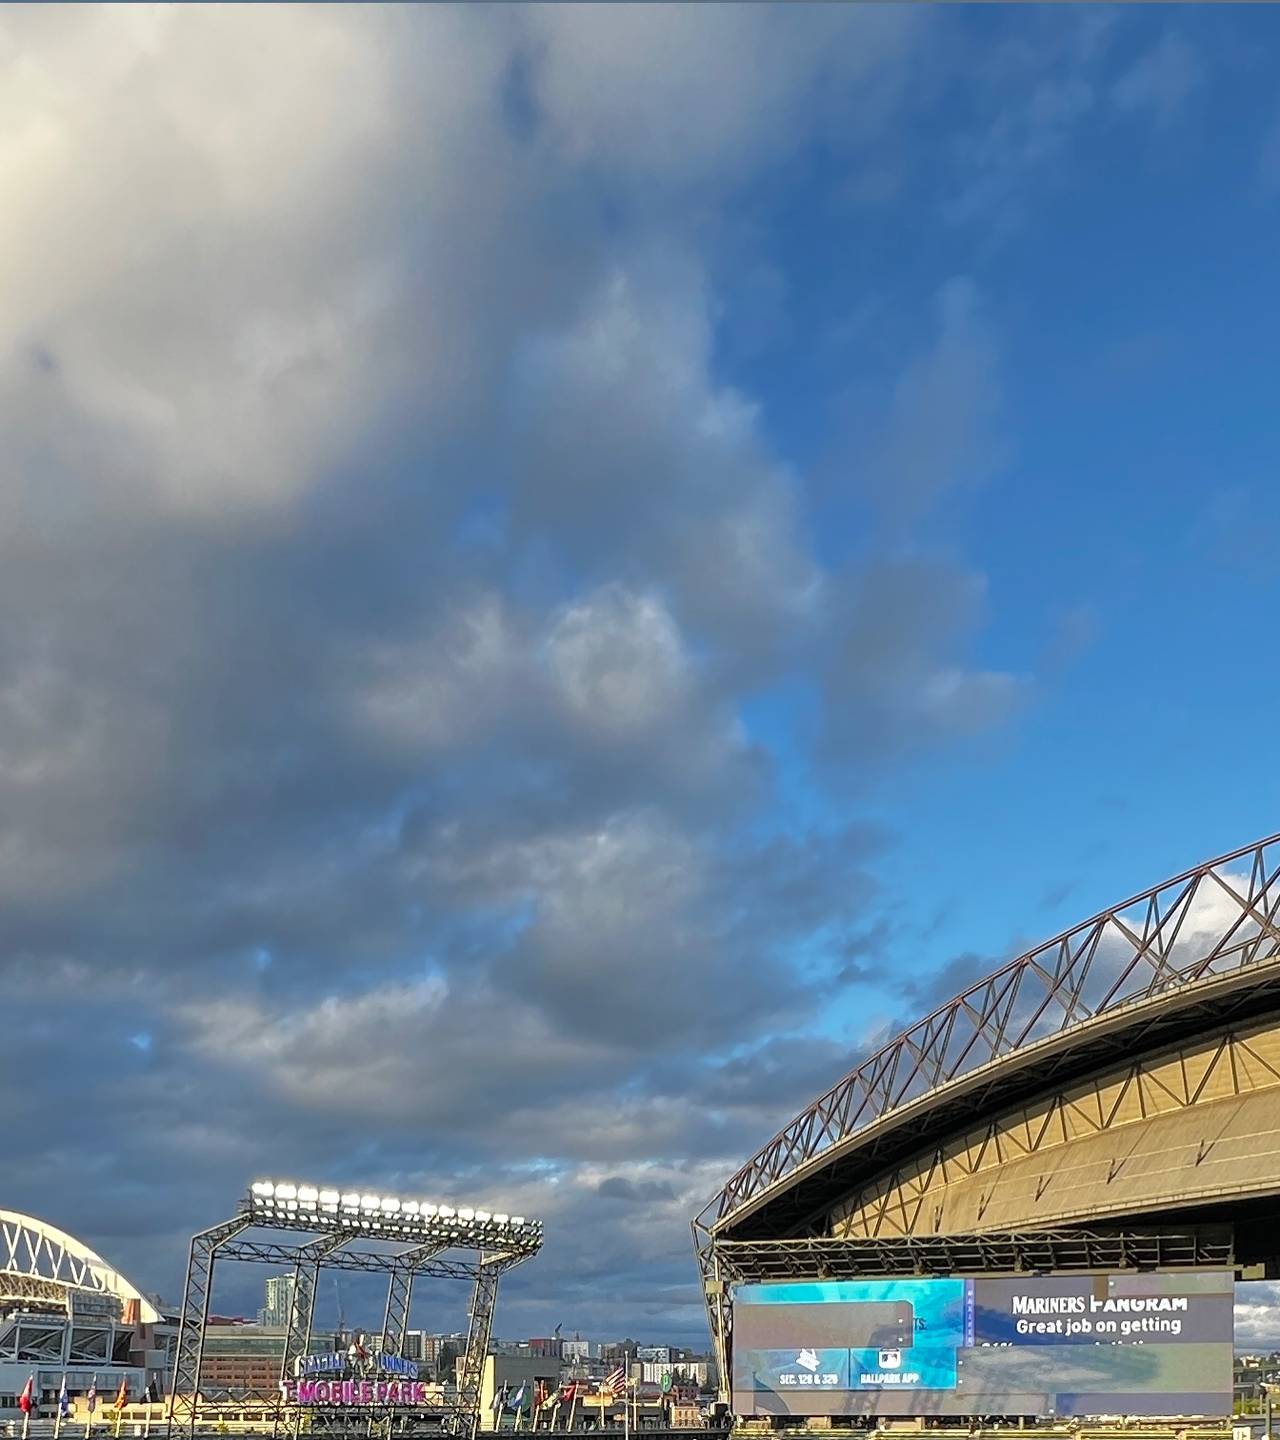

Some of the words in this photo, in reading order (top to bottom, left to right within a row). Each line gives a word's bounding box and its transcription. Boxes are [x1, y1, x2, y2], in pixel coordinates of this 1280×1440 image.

[1012, 1296, 1085, 1314] MARINERS
[1016, 1318, 1063, 1334] Great
[1065, 1318, 1092, 1336] job
[1095, 1321, 1117, 1333] on
[1120, 1317, 1182, 1336] getting
[376, 1380, 427, 1403] PARK
